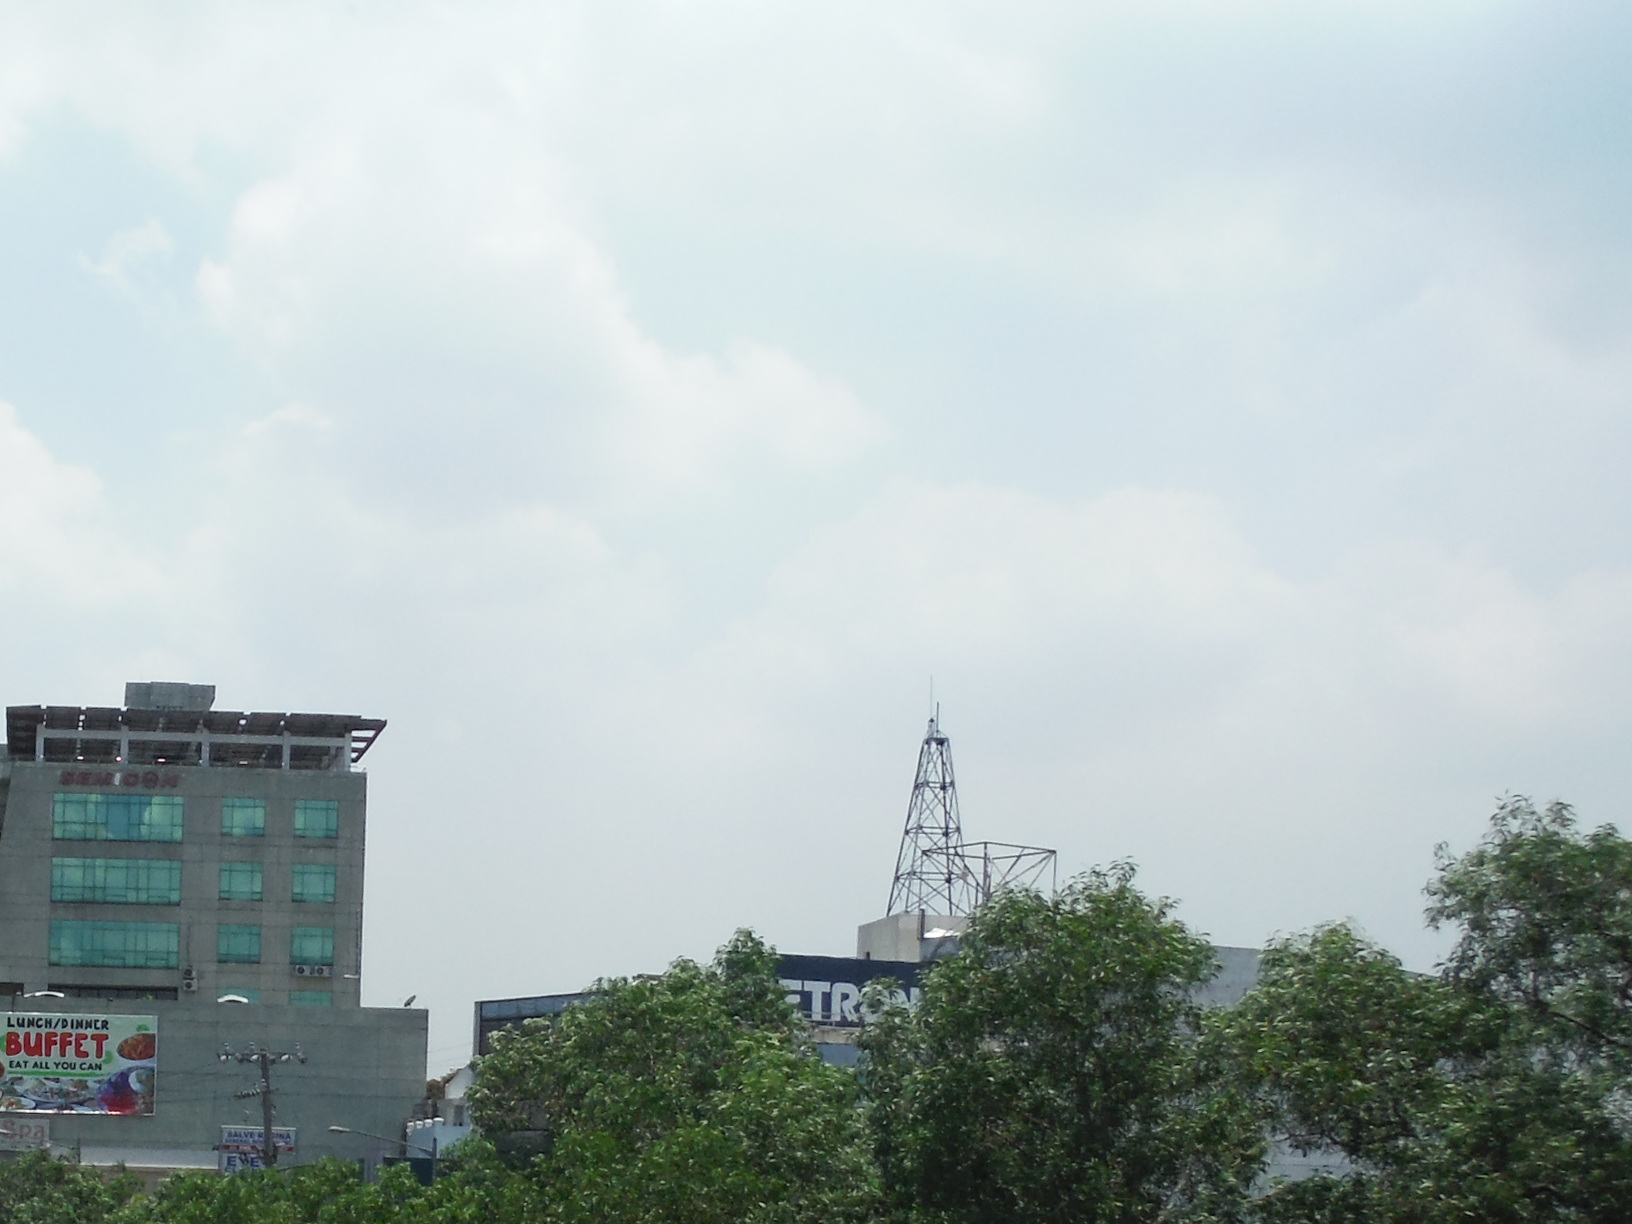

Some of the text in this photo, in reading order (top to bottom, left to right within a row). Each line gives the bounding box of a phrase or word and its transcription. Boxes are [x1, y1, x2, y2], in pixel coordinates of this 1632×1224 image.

[6, 1017, 109, 1030] LUNCH/DINNER
[5, 1031, 110, 1059] BUFFET
[8, 1060, 102, 1071] EAT ALL YOU CAN
